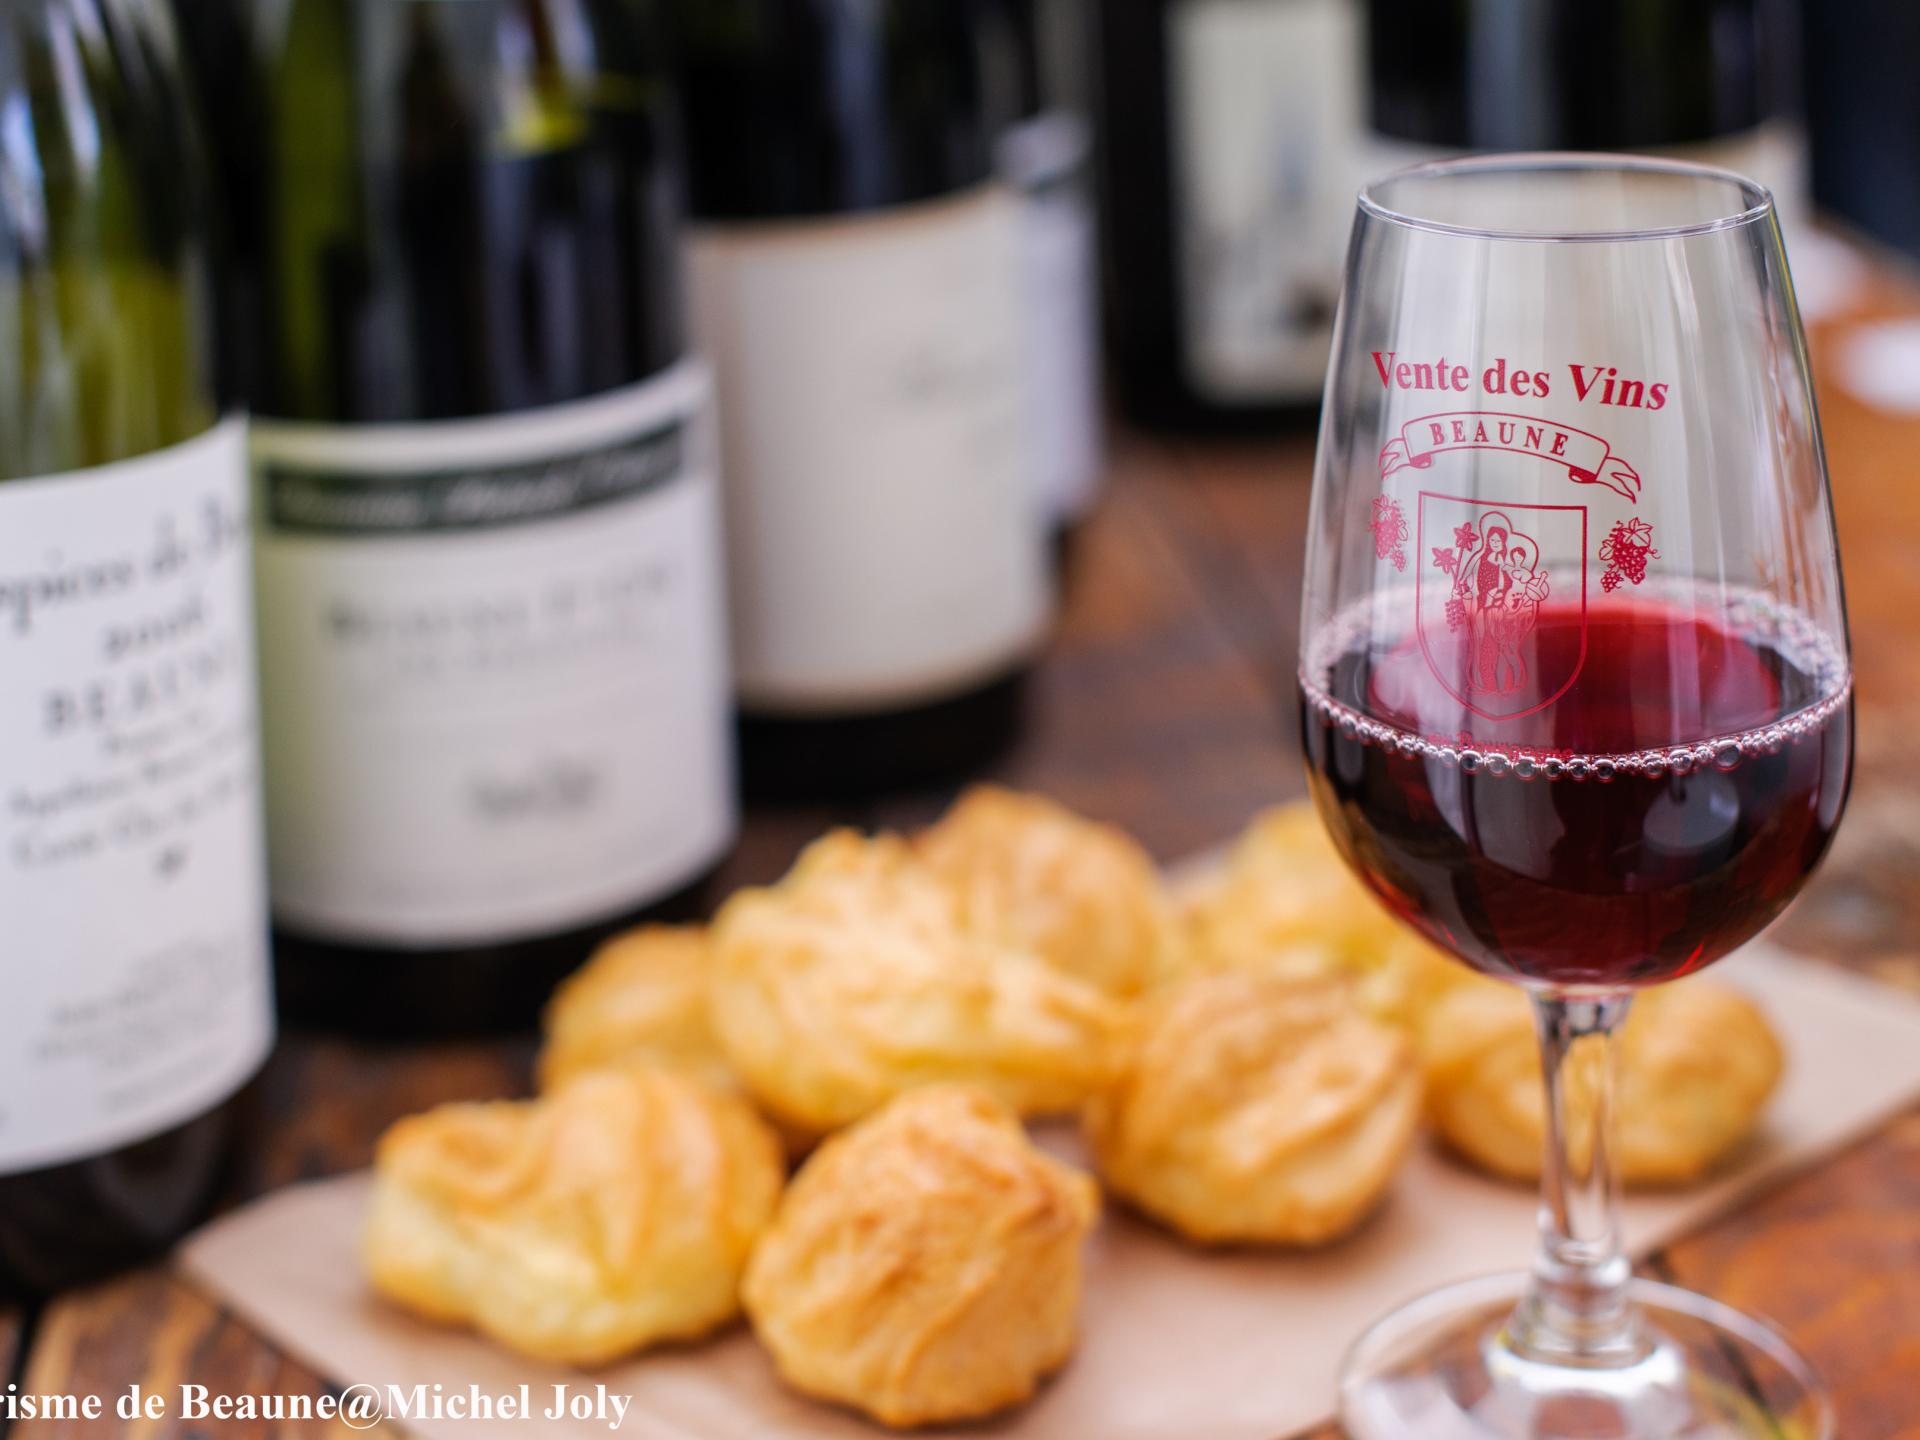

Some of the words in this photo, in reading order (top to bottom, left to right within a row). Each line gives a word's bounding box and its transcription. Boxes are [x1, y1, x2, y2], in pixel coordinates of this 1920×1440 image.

[1371, 351, 1469, 391] Vente
[1482, 358, 1551, 398] des
[1567, 364, 1669, 411] Vins
[1429, 420, 1569, 457] BEAUNE
